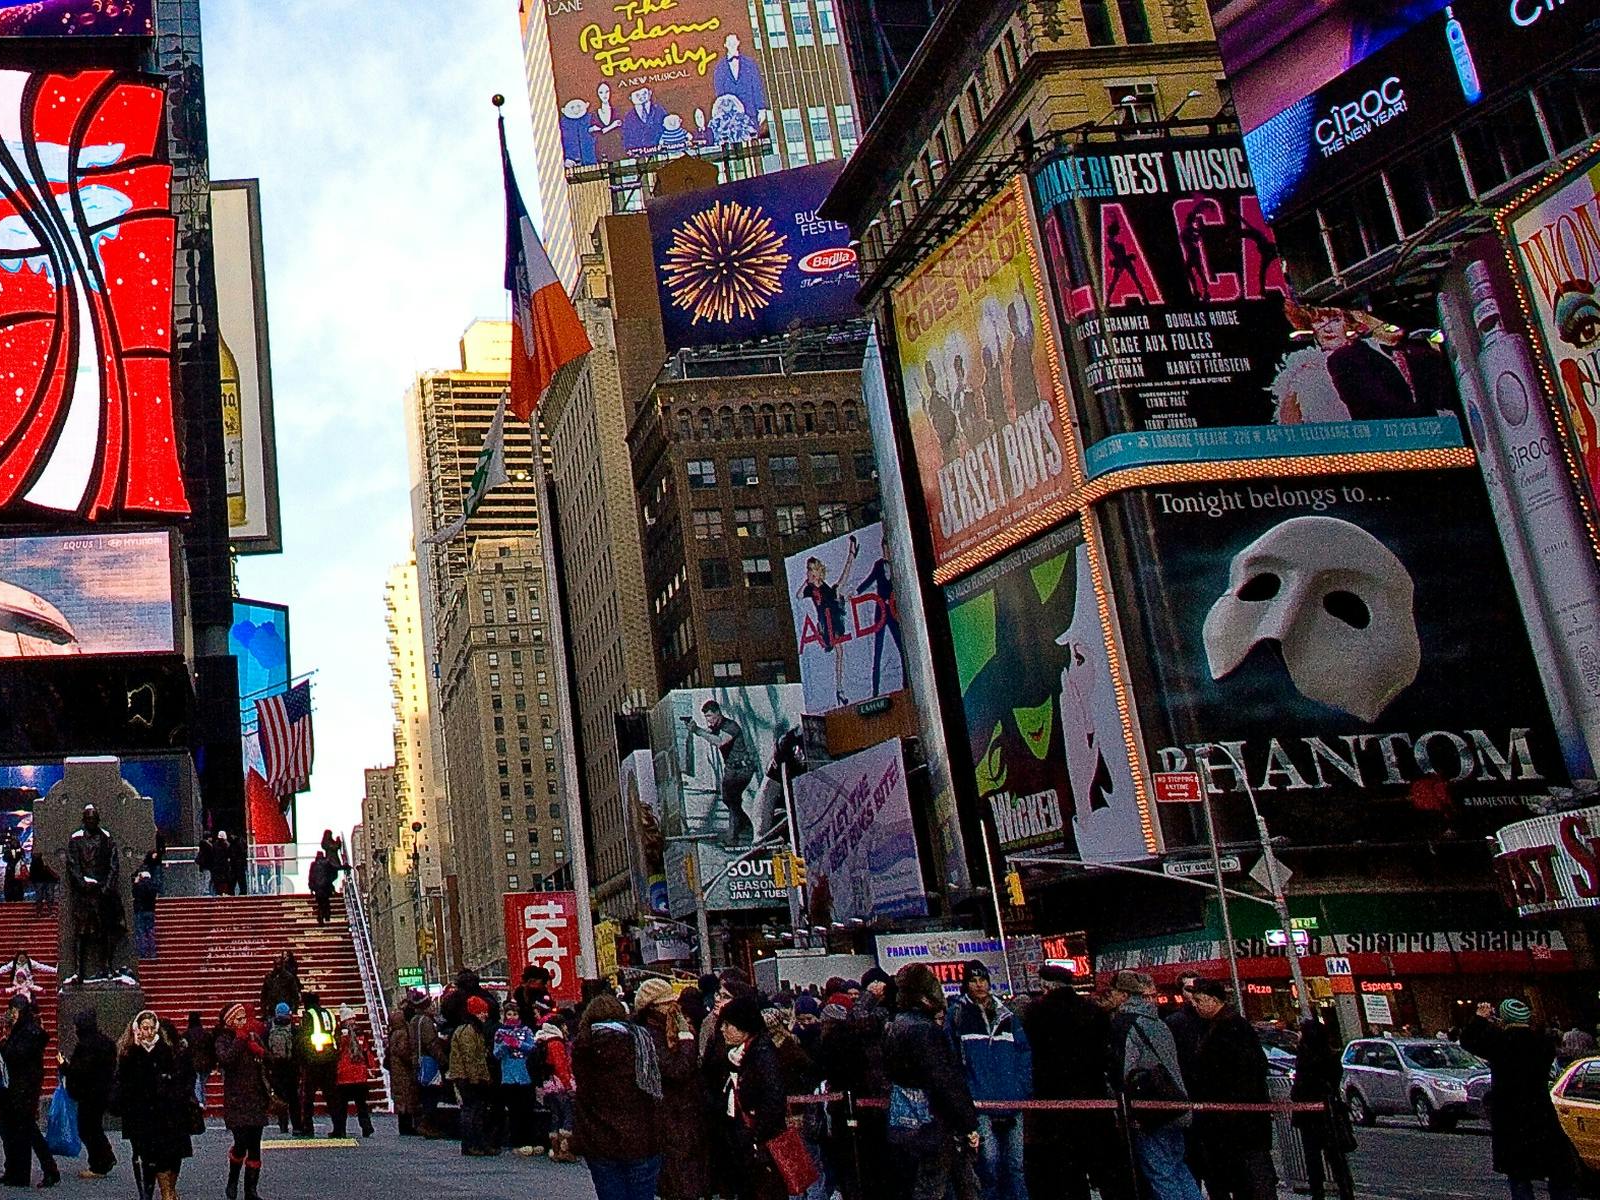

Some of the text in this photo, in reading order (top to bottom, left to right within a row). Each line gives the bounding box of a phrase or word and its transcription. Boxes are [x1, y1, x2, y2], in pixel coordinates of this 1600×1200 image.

[548, 0, 584, 16] LANE
[613, 0, 679, 21] The
[579, 16, 720, 53] Addams
[594, 42, 717, 77] Family
[617, 69, 691, 89] A NEW MUSICAL
[1315, 76, 1405, 145] CÎROC
[1321, 100, 1407, 159] THE NEW YEAR!
[1035, 148, 1253, 203] WINNER! BEST MUSIC
[1077, 187, 1114, 198] AWARD
[905, 279, 959, 343] GOES
[1104, 310, 1240, 332] GRAMMER DOUGLAS HODGE
[1095, 332, 1214, 357] LA CAGE AUX FOLLES
[1107, 364, 1145, 381] HERMAN
[1166, 359, 1203, 376] HARVEY
[938, 400, 1062, 540] JERSEY BOYS
[1155, 487, 1330, 519] Tonight belongs
[63, 537, 163, 550] EQUUS HYUNDAI
[1156, 728, 1545, 793] PHANTOM
[1157, 775, 1194, 783] NO STOPPING
[830, 773, 871, 842] LET THE
[1472, 797, 1518, 807] MAJESTIC
[989, 789, 1063, 844] WICKED
[727, 860, 774, 877] SOUT
[1173, 863, 1190, 873] city
[730, 891, 750, 899] JAN.
[524, 901, 568, 988] tkts
[887, 945, 929, 957] PHANTOM
[1248, 984, 1272, 994] Pizza
